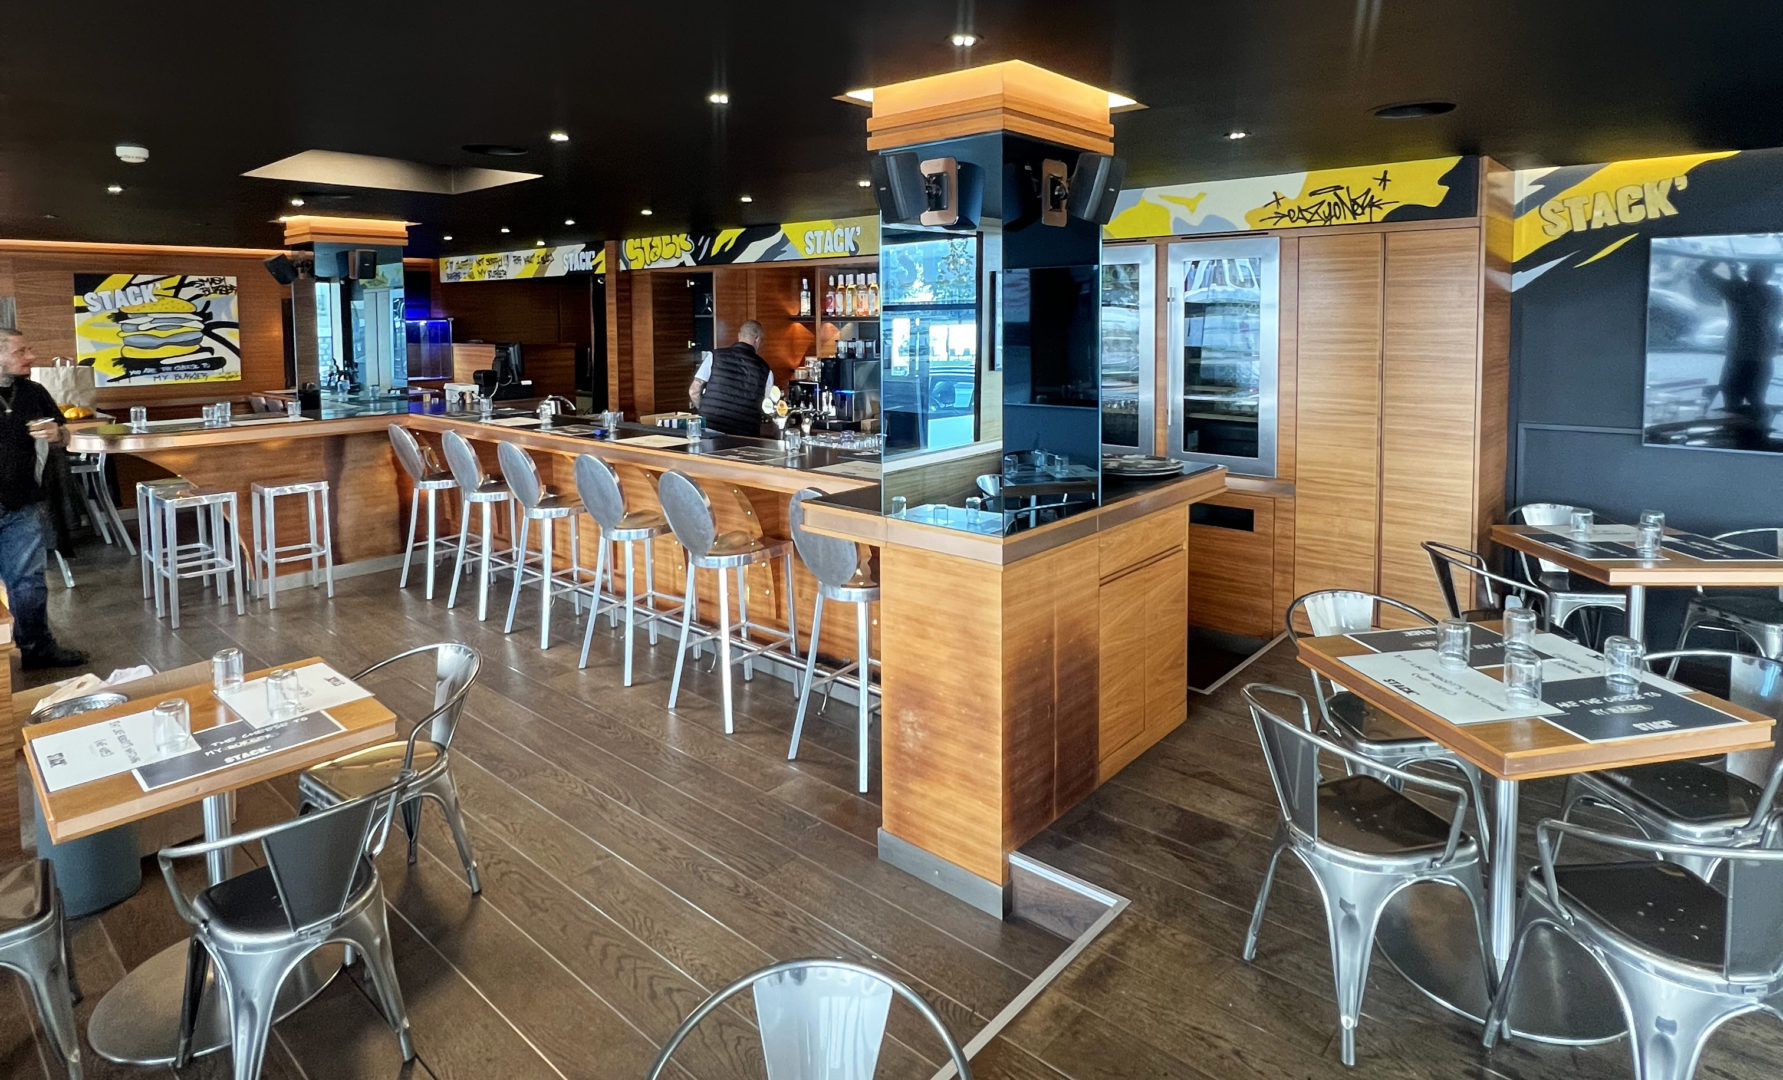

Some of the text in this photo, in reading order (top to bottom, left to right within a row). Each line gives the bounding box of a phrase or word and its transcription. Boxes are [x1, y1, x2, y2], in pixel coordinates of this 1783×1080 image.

[1539, 175, 1688, 237] STACK'
[804, 226, 861, 255] STACK'
[563, 251, 595, 271] STACK'
[84, 283, 161, 312] STACK'
[204, 748, 223, 757] MY
[223, 746, 272, 764] STACK'
